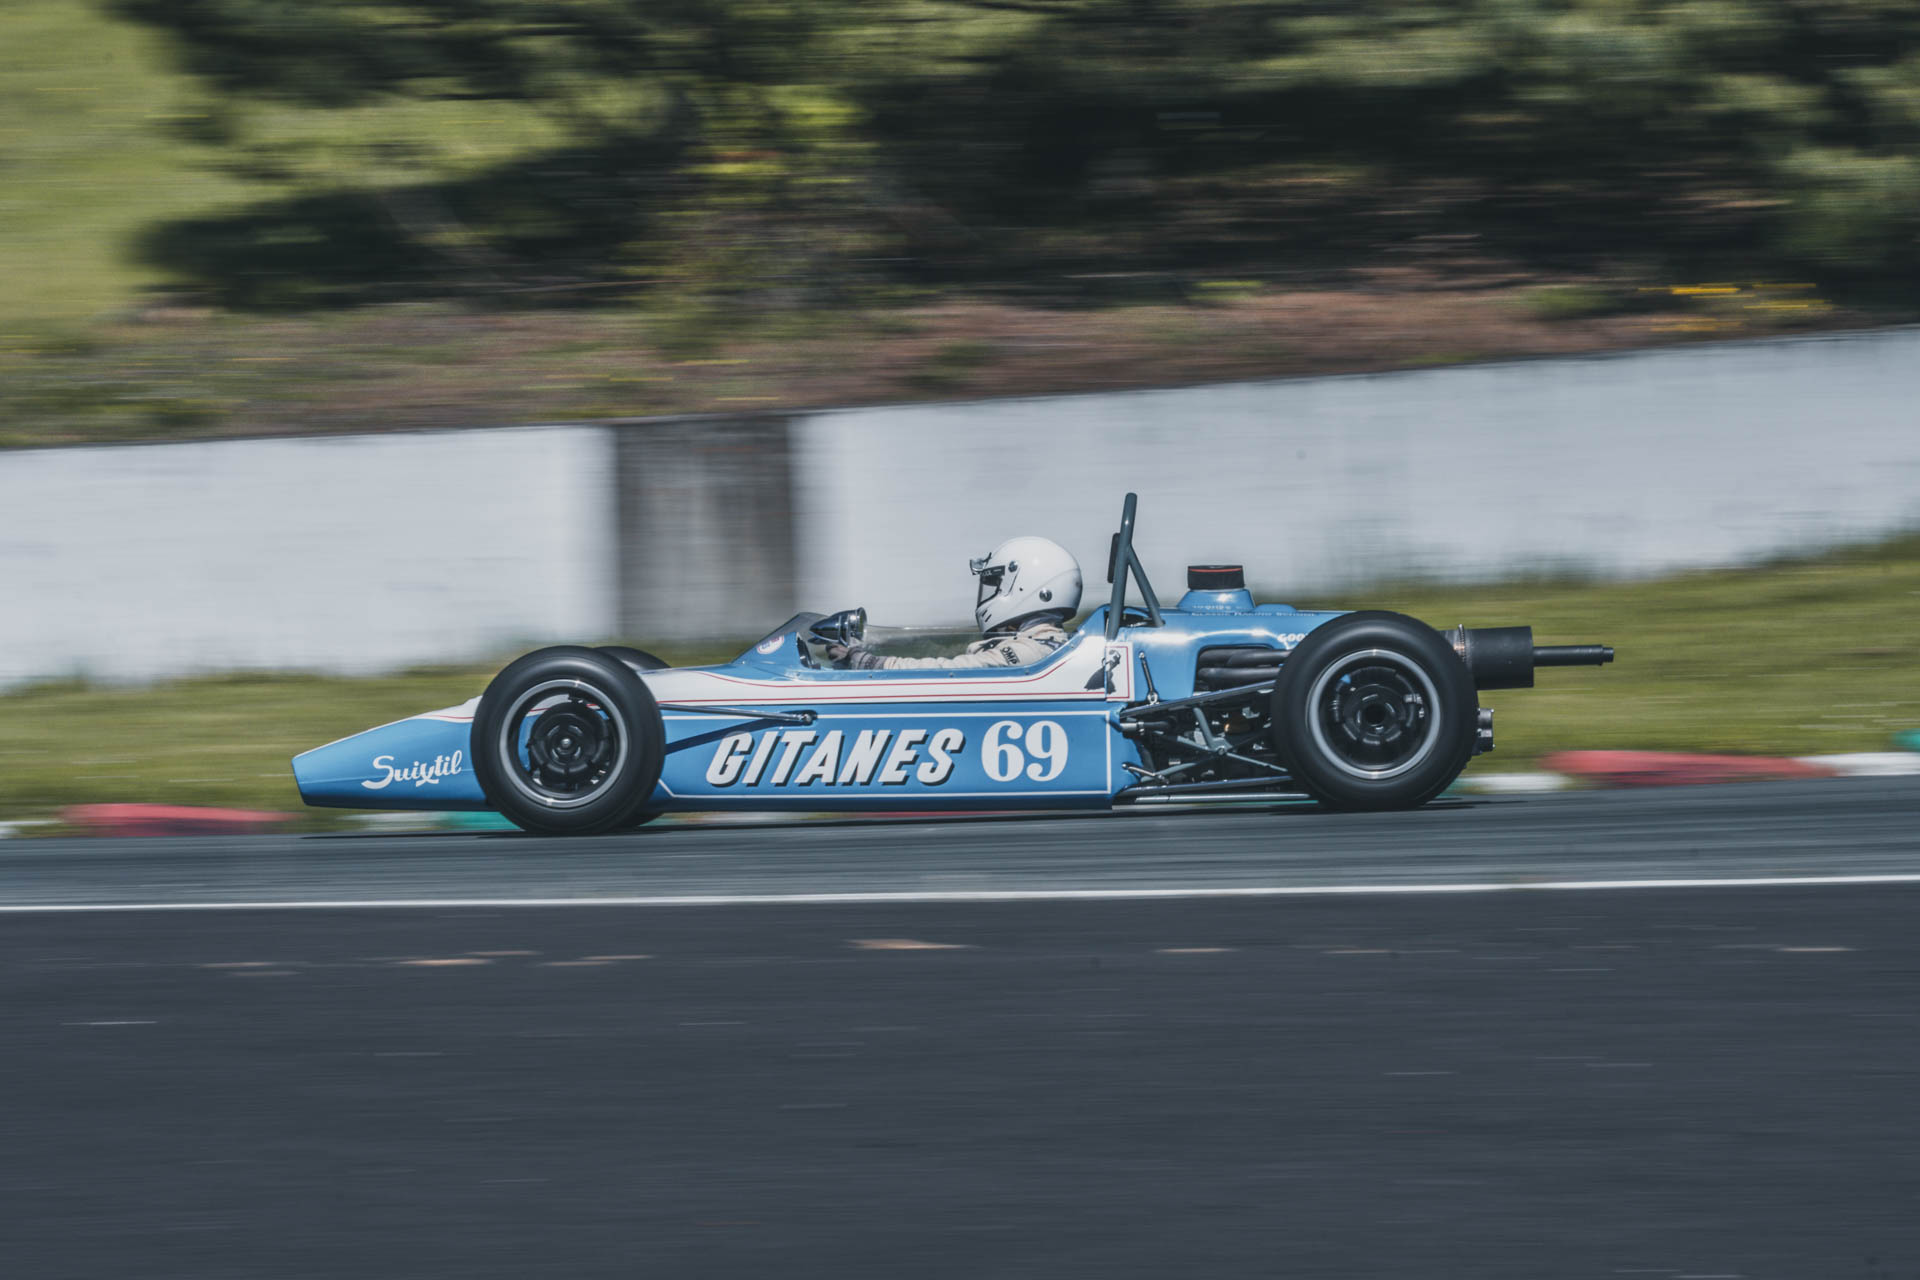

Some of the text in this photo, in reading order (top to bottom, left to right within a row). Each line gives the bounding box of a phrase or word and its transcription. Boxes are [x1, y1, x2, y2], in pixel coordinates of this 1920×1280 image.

[1277, 632, 1308, 643] GOO
[1001, 646, 1020, 665] OMP
[705, 720, 1069, 787] GITANES 69
